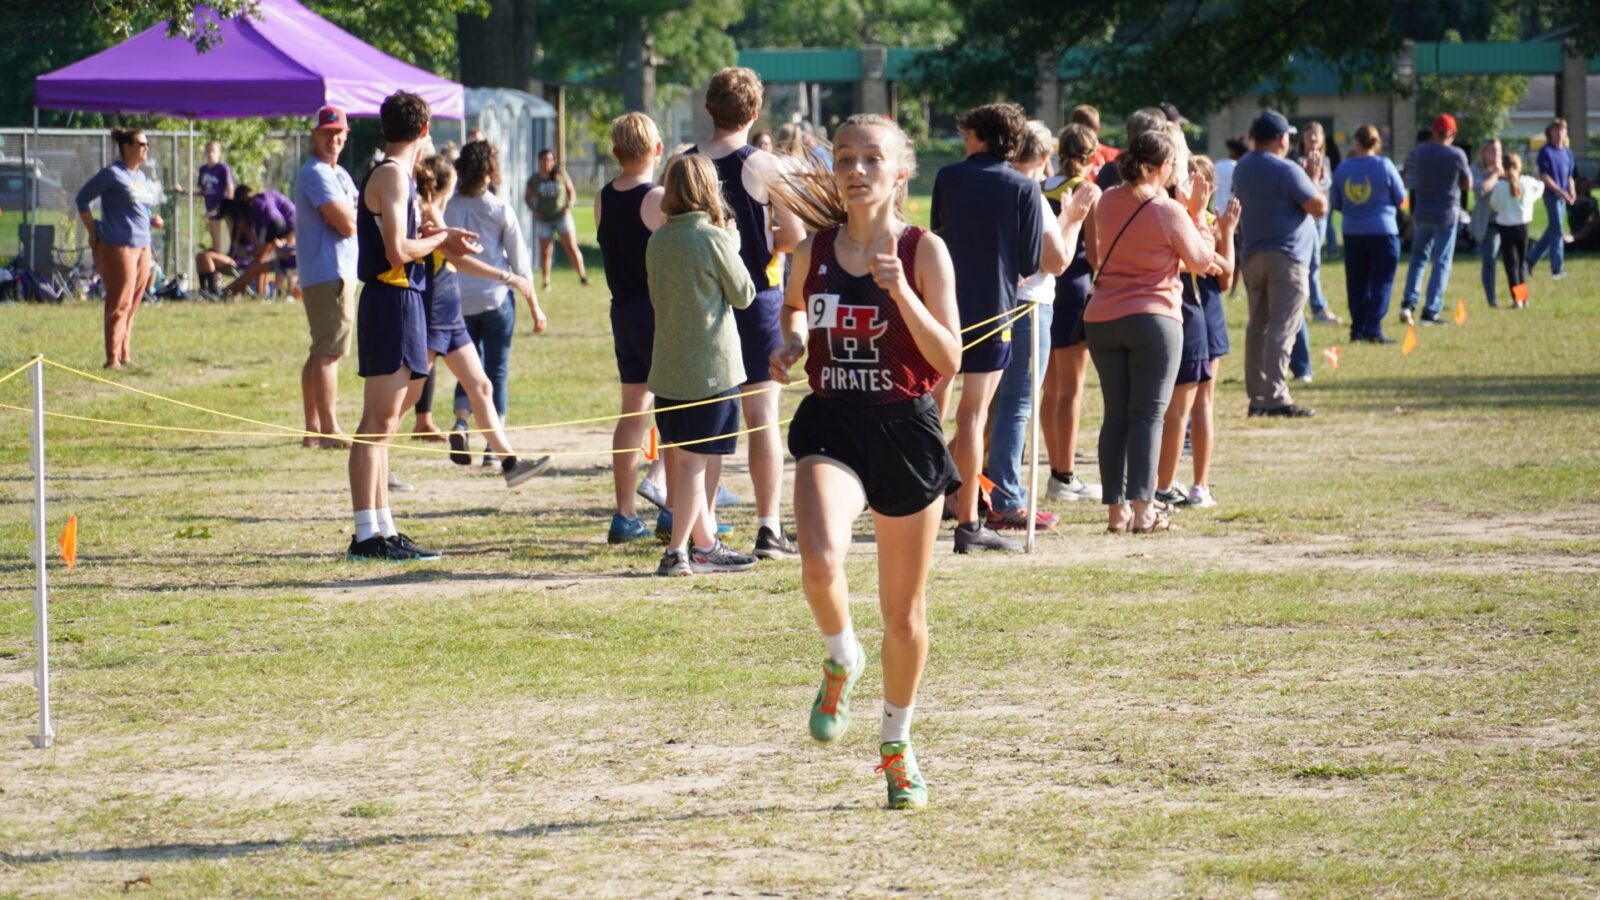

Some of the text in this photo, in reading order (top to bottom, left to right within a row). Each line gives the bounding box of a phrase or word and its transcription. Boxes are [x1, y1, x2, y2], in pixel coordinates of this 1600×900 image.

[813, 298, 826, 326] 9
[828, 305, 888, 362] H
[821, 367, 893, 391] PIRATES
